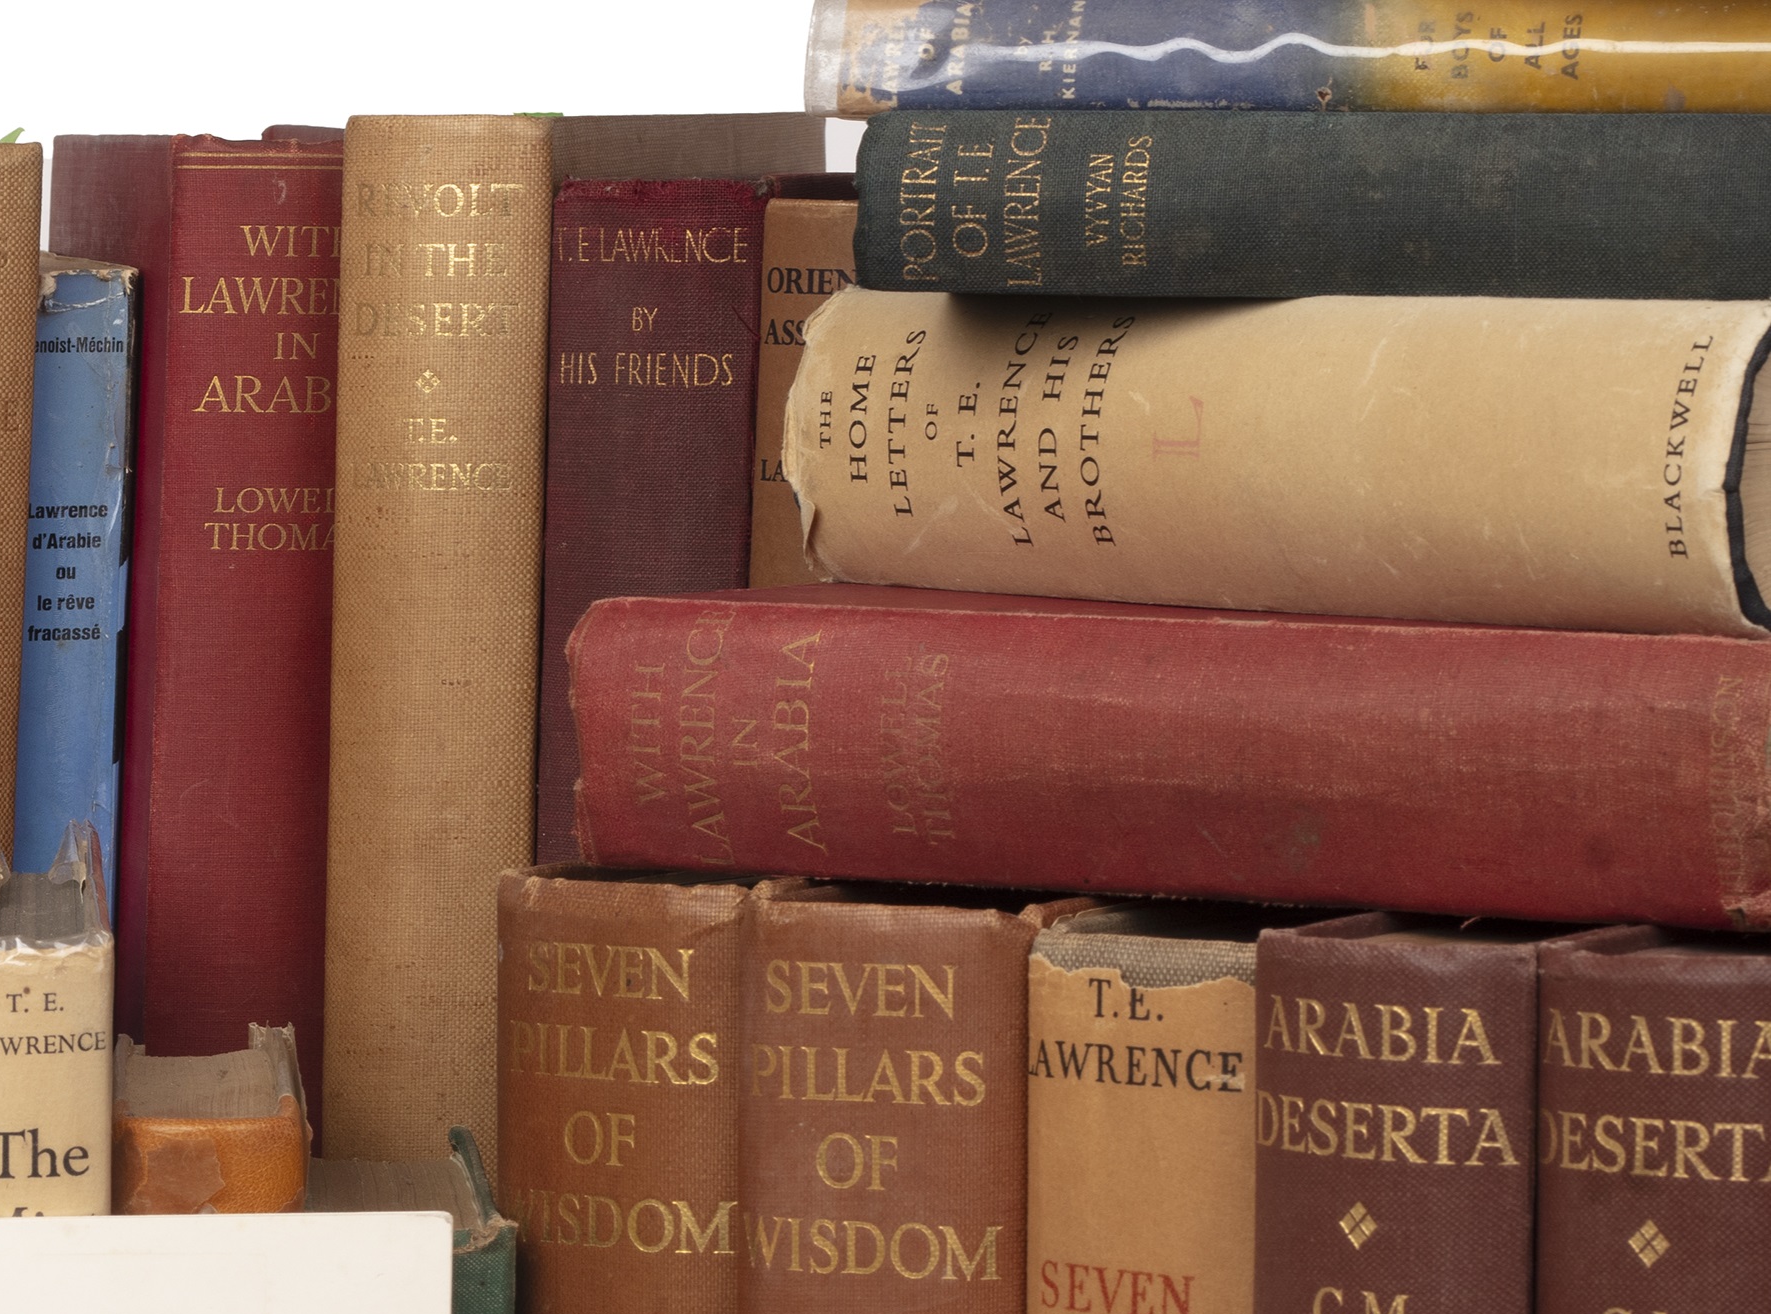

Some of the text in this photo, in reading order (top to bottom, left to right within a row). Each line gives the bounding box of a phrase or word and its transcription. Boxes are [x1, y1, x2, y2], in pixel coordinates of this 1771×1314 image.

[1451, 11, 1473, 80] BOYS
[1488, 27, 1508, 63] OF
[1524, 21, 1546, 70] ALL
[1561, 13, 1584, 81] AGES
[355, 183, 524, 218] REVOLT
[899, 121, 947, 282] PORTRAIT
[952, 203, 989, 258] OF
[1003, 117, 1053, 287] LAWRENCE
[1085, 153, 1114, 247] VYVYAN
[1119, 135, 1153, 268] RICHARDS
[417, 243, 507, 276] THE
[599, 227, 748, 263] LAWRENCE
[274, 332, 321, 360] IN
[354, 302, 520, 336] DESERT
[632, 308, 657, 331] BY
[559, 352, 734, 387] HIS FRIENDS
[820, 390, 833, 449] THE
[848, 354, 876, 483] HOME
[887, 329, 927, 518] LETTERS
[925, 403, 939, 440] OF
[996, 311, 1053, 547] LAWRENCE
[1038, 335, 1080, 522] AND HIS
[1080, 314, 1136, 547] BROTHERS
[1664, 335, 1714, 559] BLACKWELL
[28, 502, 108, 520] Lawrence
[32, 532, 102, 550] d'Arabie
[37, 594, 95, 612] le rêve
[56, 565, 76, 581] ou
[28, 624, 102, 642] fracassé
[632, 659, 666, 805] WITH
[678, 607, 736, 865] LAWRENCE
[732, 717, 758, 767] IN
[774, 629, 829, 855] ARABIA
[528, 941, 694, 999] SEVEN
[765, 958, 958, 1020] SEVEN
[510, 1019, 719, 1085] PILLARS
[1264, 993, 1502, 1066] ARABIA
[751, 1044, 986, 1107] PILLARS
[564, 1111, 635, 1166] OF
[1257, 1089, 1520, 1167] DESERTA
[816, 1131, 898, 1191] OF
[743, 1212, 1004, 1281] WISDOM
